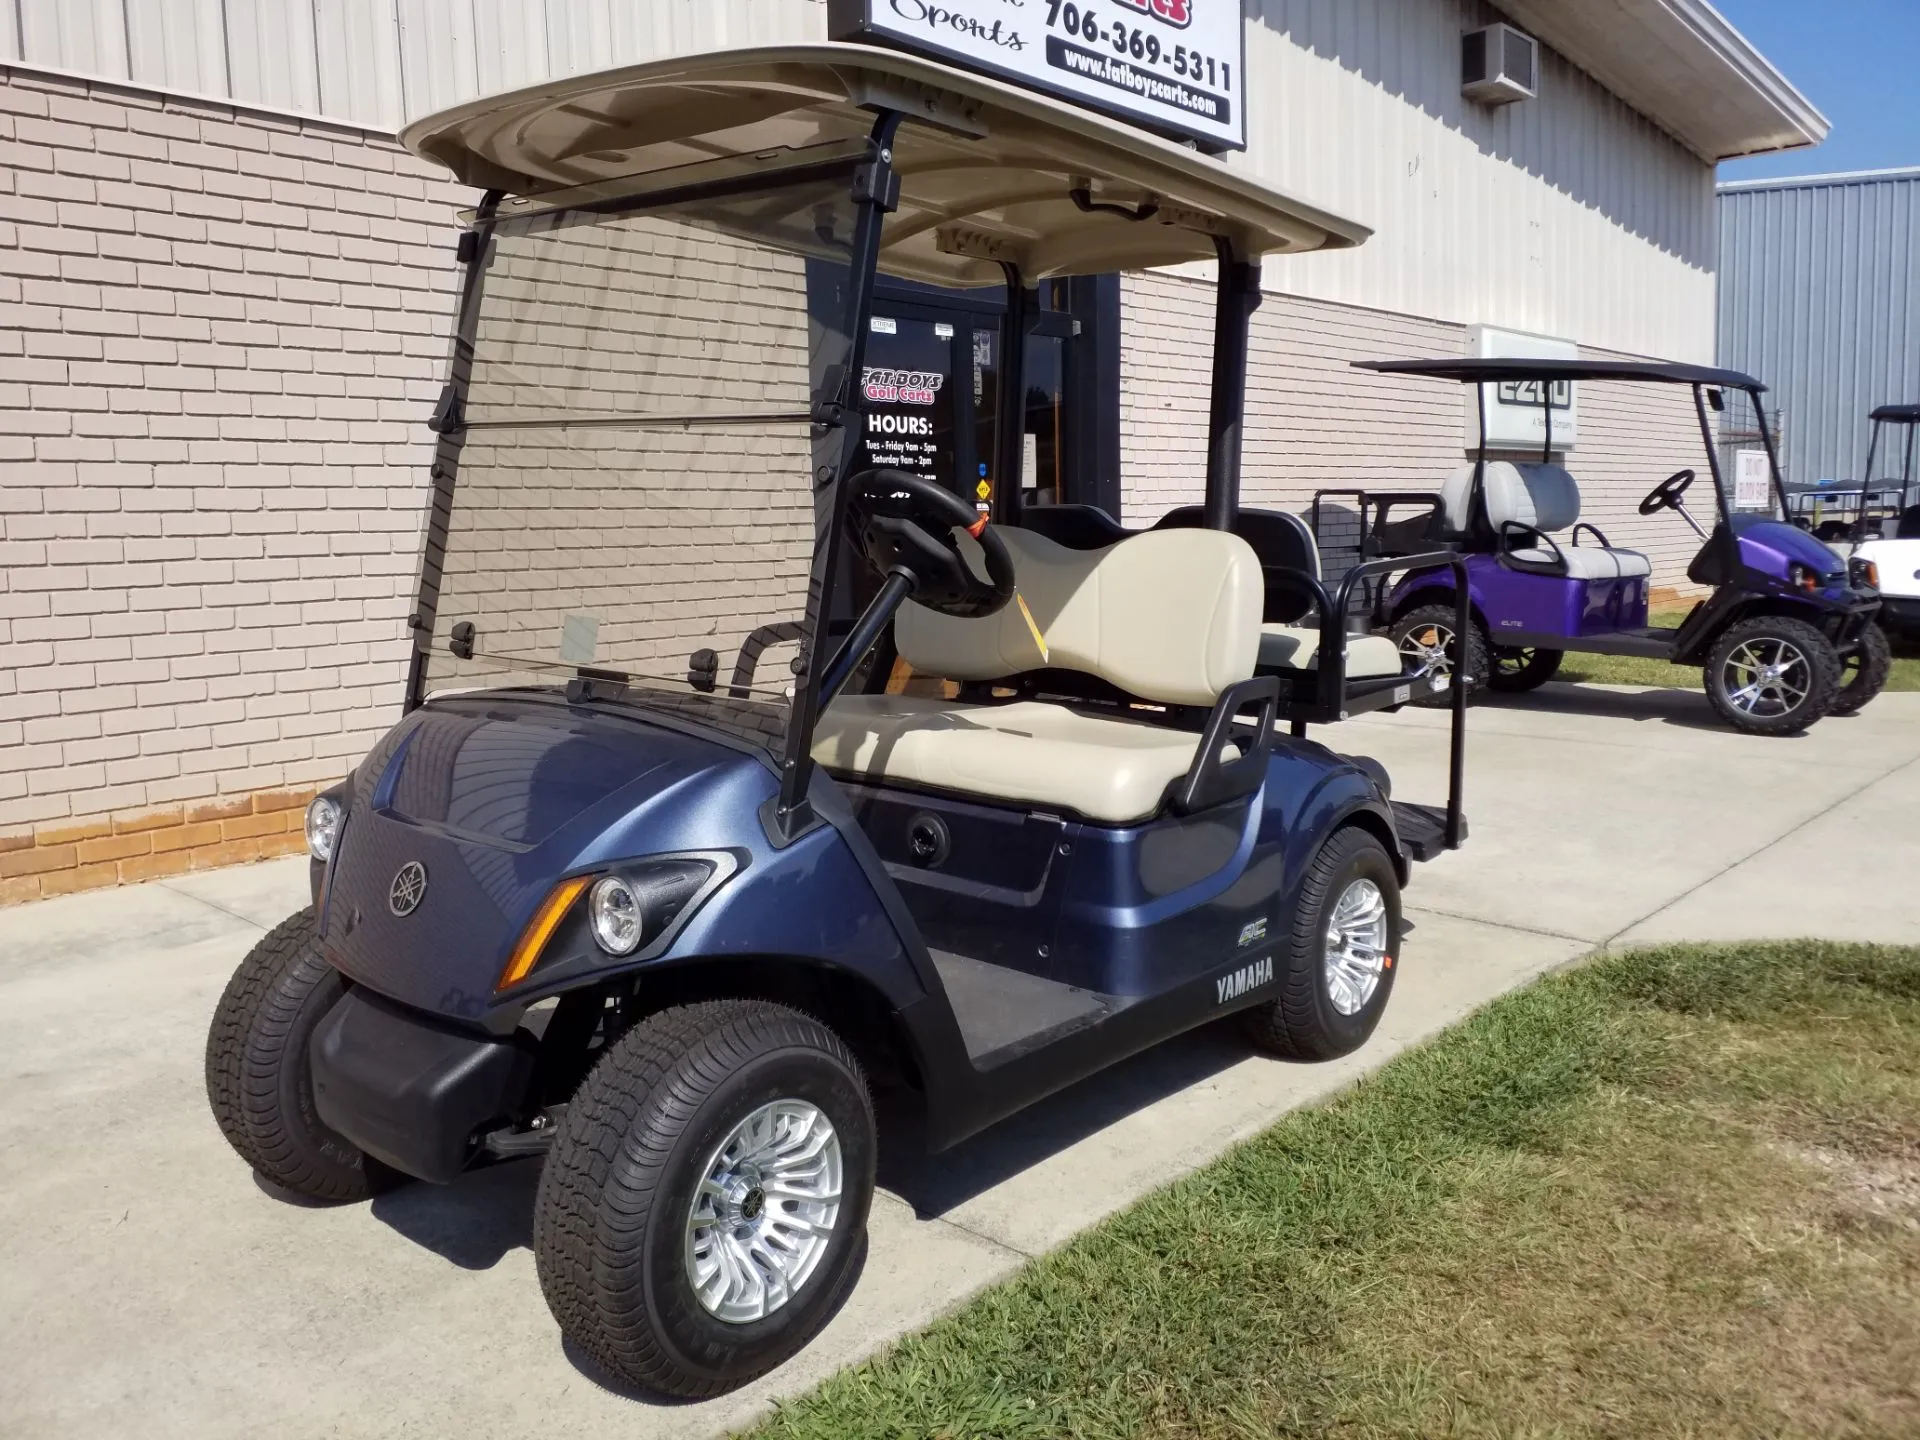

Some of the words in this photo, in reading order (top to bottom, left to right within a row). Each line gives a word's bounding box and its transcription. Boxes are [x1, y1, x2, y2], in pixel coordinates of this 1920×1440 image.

[1045, 0, 1231, 91] 706-369-5311
[1064, 48, 1217, 116] www.fatboyscarts.com
[895, 372, 942, 390] BOYS
[867, 385, 897, 400] Golf
[899, 387, 933, 402] Carts
[868, 414, 933, 435] HOURS:
[866, 440, 880, 450] Tues
[885, 441, 904, 453] Friday
[905, 442, 919, 451] 9am
[924, 443, 937, 454] 5pm
[872, 454, 899, 467] Saturday
[900, 455, 914, 465] 9am
[918, 456, 932, 467] 2pm
[1216, 956, 1273, 1005] YAMAHA
